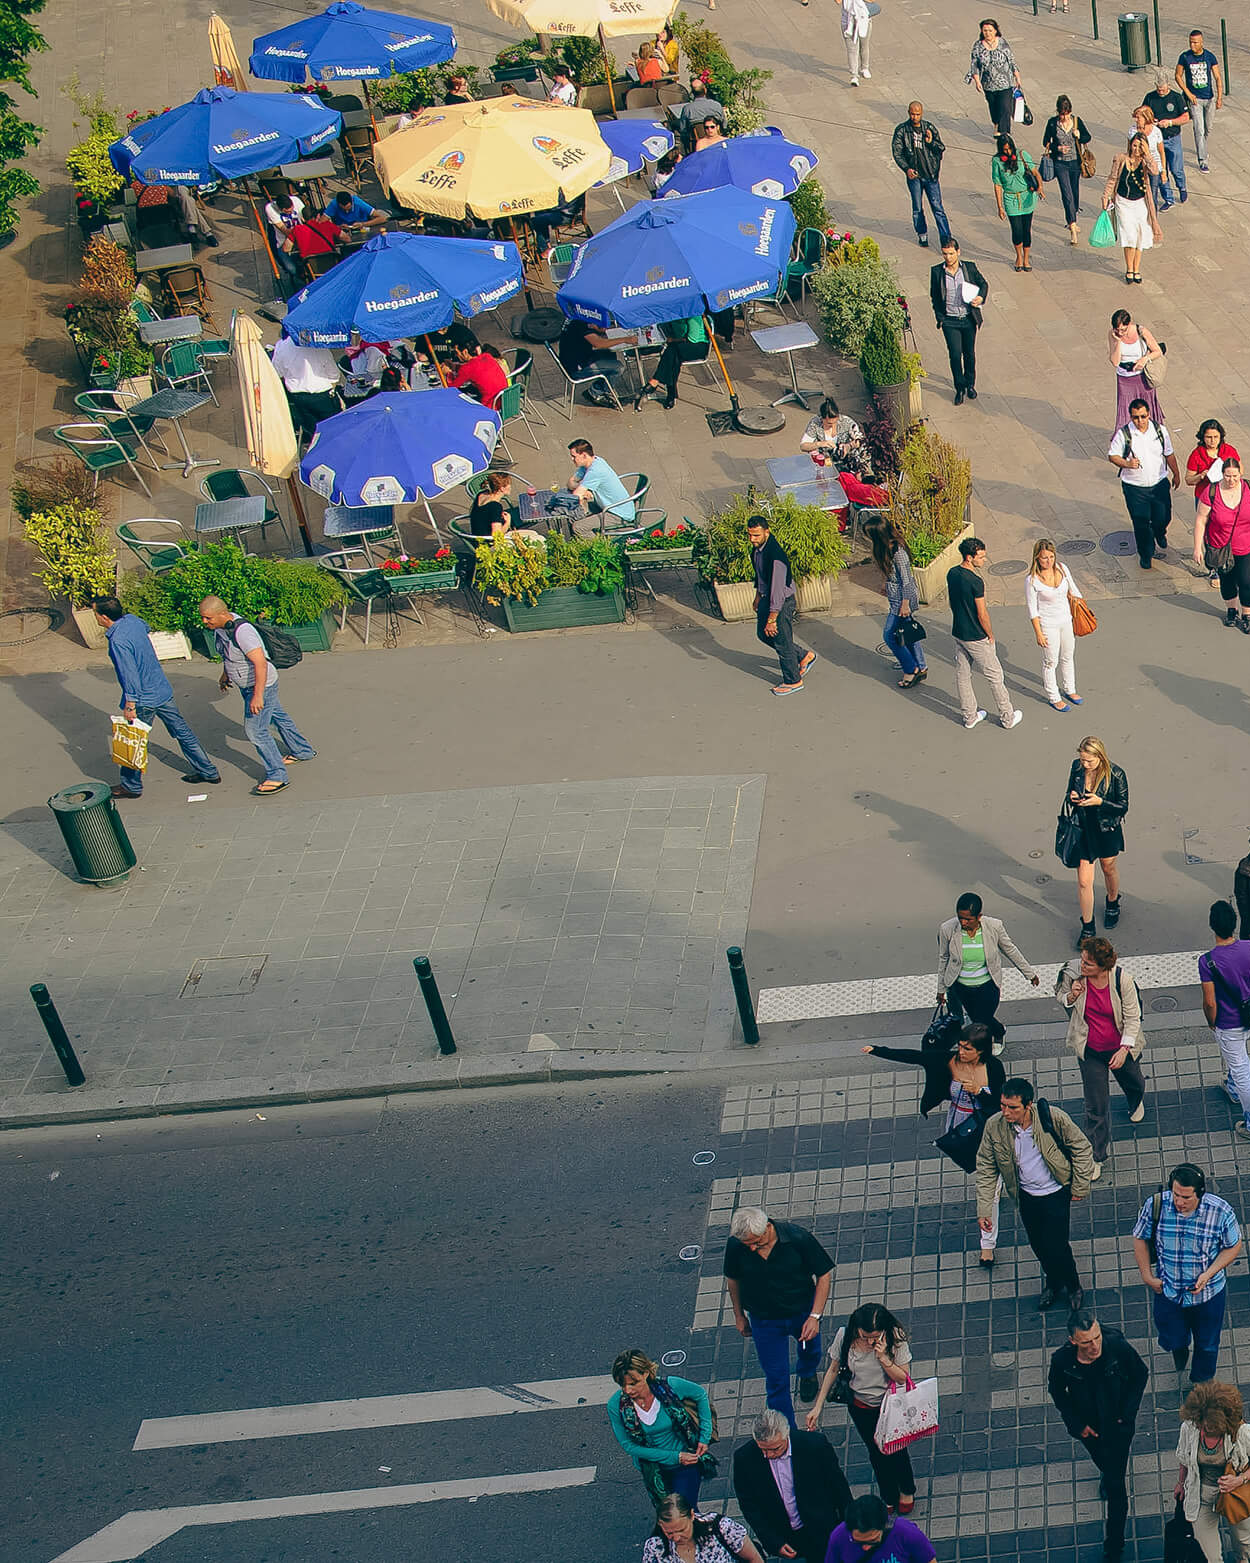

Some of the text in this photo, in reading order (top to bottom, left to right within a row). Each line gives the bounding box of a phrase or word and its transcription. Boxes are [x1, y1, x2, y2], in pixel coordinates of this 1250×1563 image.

[609, 1, 645, 13] Leffe
[558, 22, 577, 32] Leffe
[336, 65, 380, 77] Hoegaarden
[213, 131, 280, 154] Hoegaarden
[552, 147, 586, 170] Leffe
[159, 170, 201, 181] Hoegaarden
[416, 170, 457, 189] Leffe
[511, 199, 535, 210] Leffe
[754, 206, 777, 257] Hoegaarden
[480, 278, 520, 305] Hoegaarden
[621, 276, 692, 298] Hoegaarden
[728, 280, 770, 301] Hoegaarden
[365, 288, 441, 313] Hoegaarden
